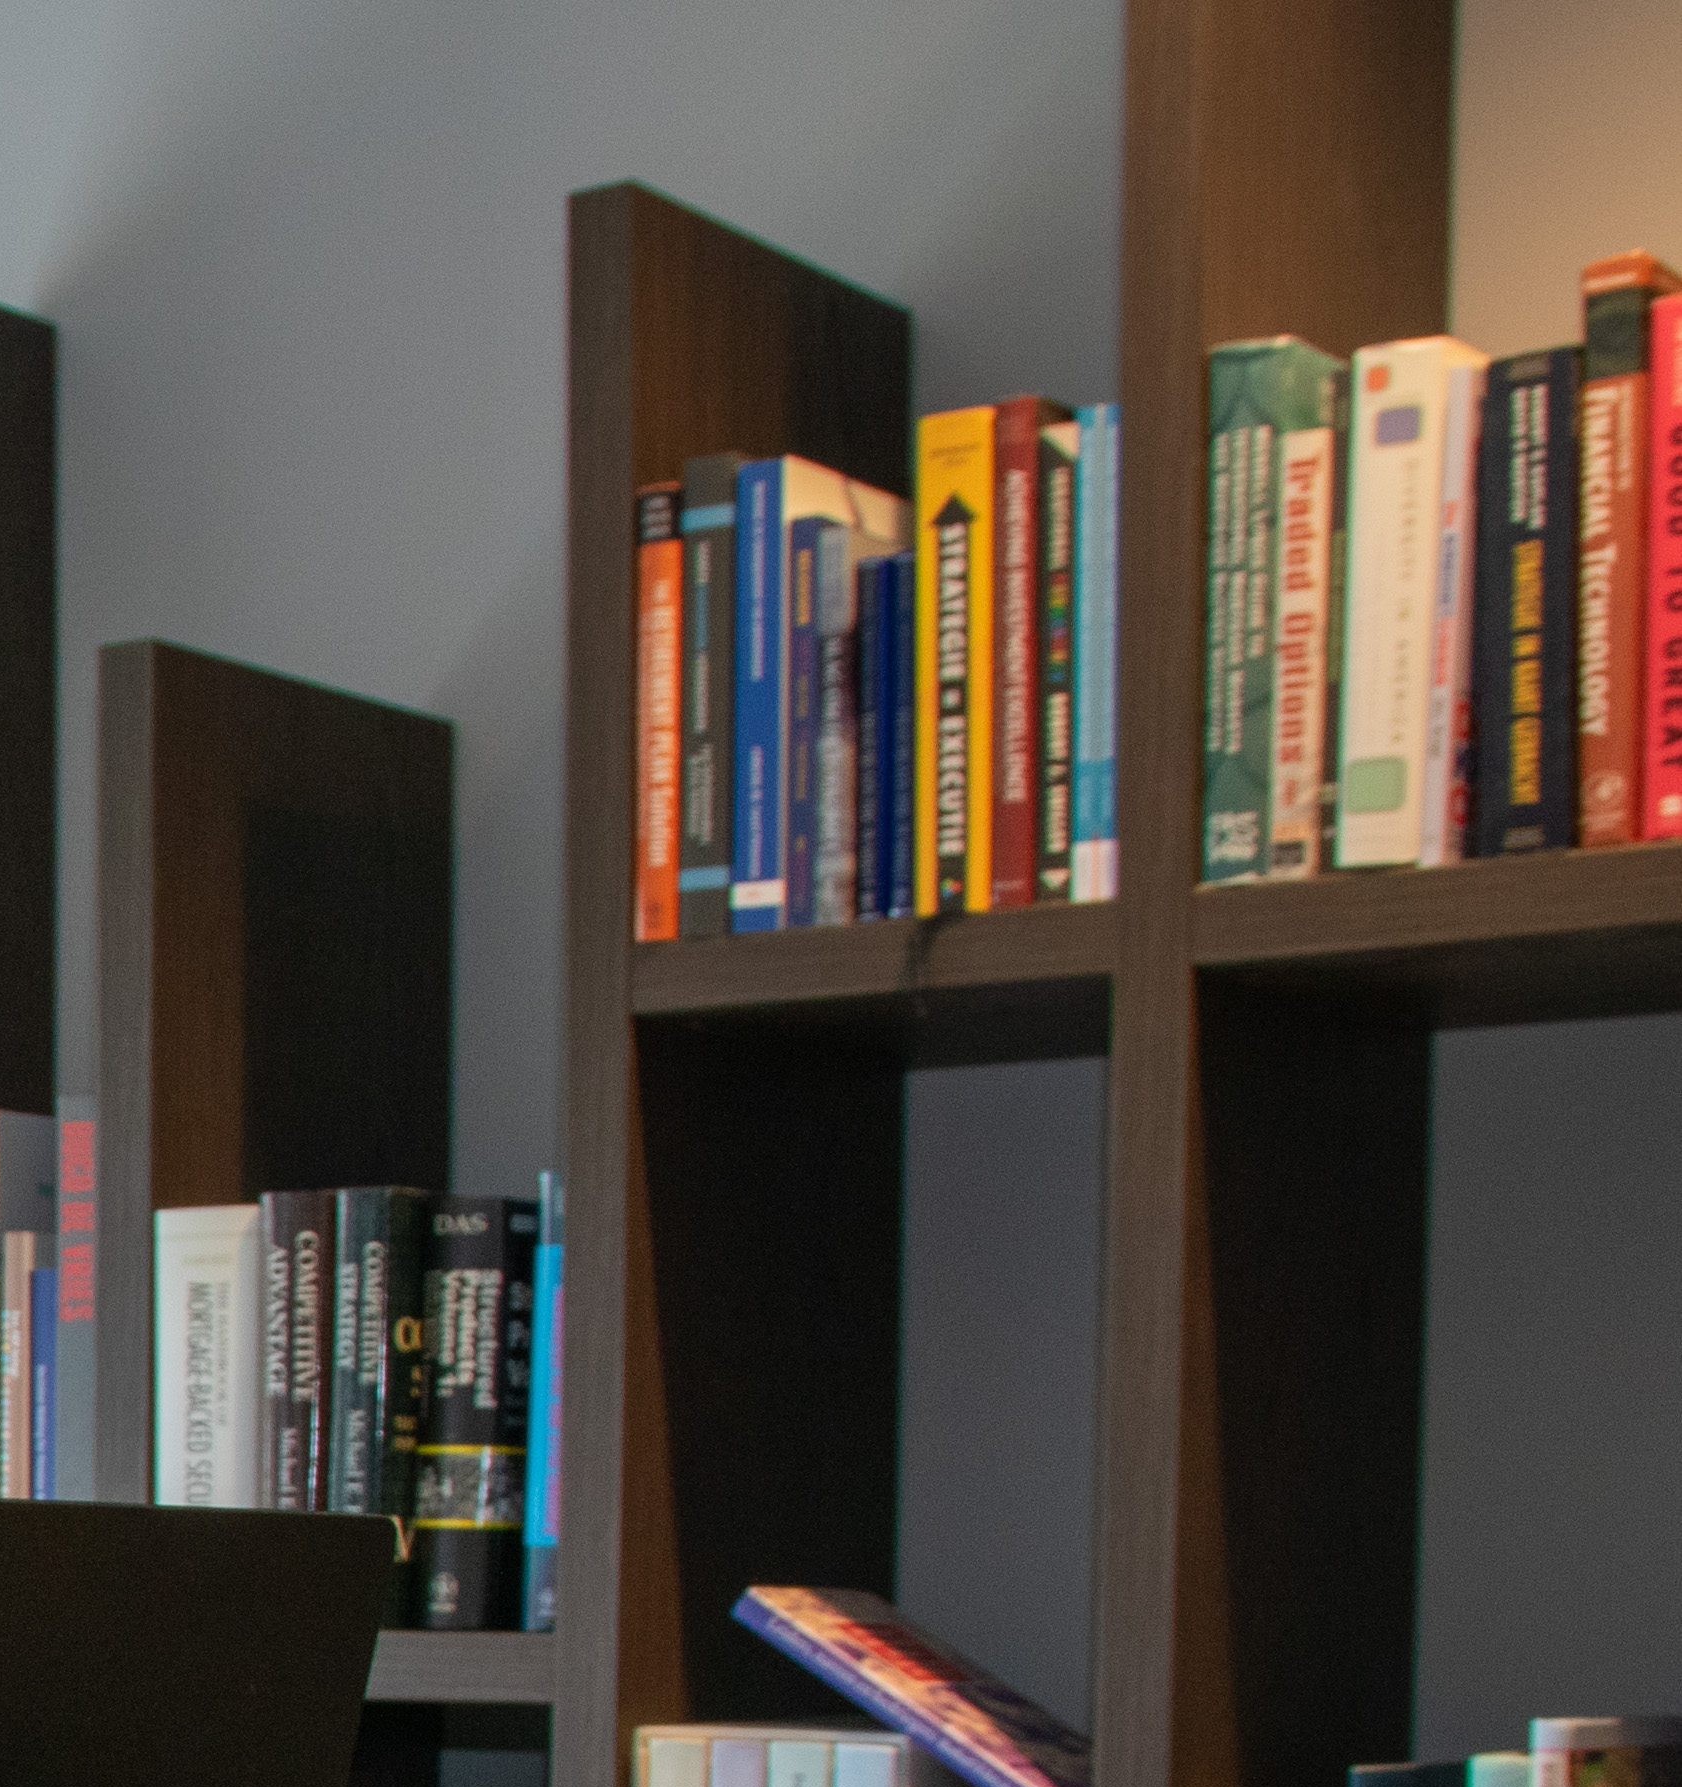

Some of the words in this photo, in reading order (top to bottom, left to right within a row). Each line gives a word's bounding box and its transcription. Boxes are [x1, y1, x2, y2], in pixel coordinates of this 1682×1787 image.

[1281, 457, 1322, 594] Traded
[1582, 387, 1618, 542] FINANCIAL
[939, 524, 967, 680] STRATEGIE
[1581, 542, 1618, 737] TECHNOLOGY
[649, 731, 675, 784] PLAN
[1275, 612, 1317, 765] Options
[938, 717, 967, 857] EXECUTIE
[61, 1244, 95, 1321] VRIES
[62, 1201, 95, 1232] DE
[433, 1212, 489, 1236] DAS
[185, 1282, 214, 1454] MORTGAGE-BACKED
[266, 1245, 289, 1398] ADVANTAGE
[292, 1230, 320, 1402] COMPETITIVE
[336, 1261, 359, 1371] STRATEGY
[357, 1241, 385, 1385] COMPETITIVE
[439, 1269, 462, 1367] Volume
[456, 1269, 482, 1386] Products
[473, 1269, 504, 1409] Structured
[279, 1427, 298, 1494] Michael
[346, 1409, 368, 1478] Michael
